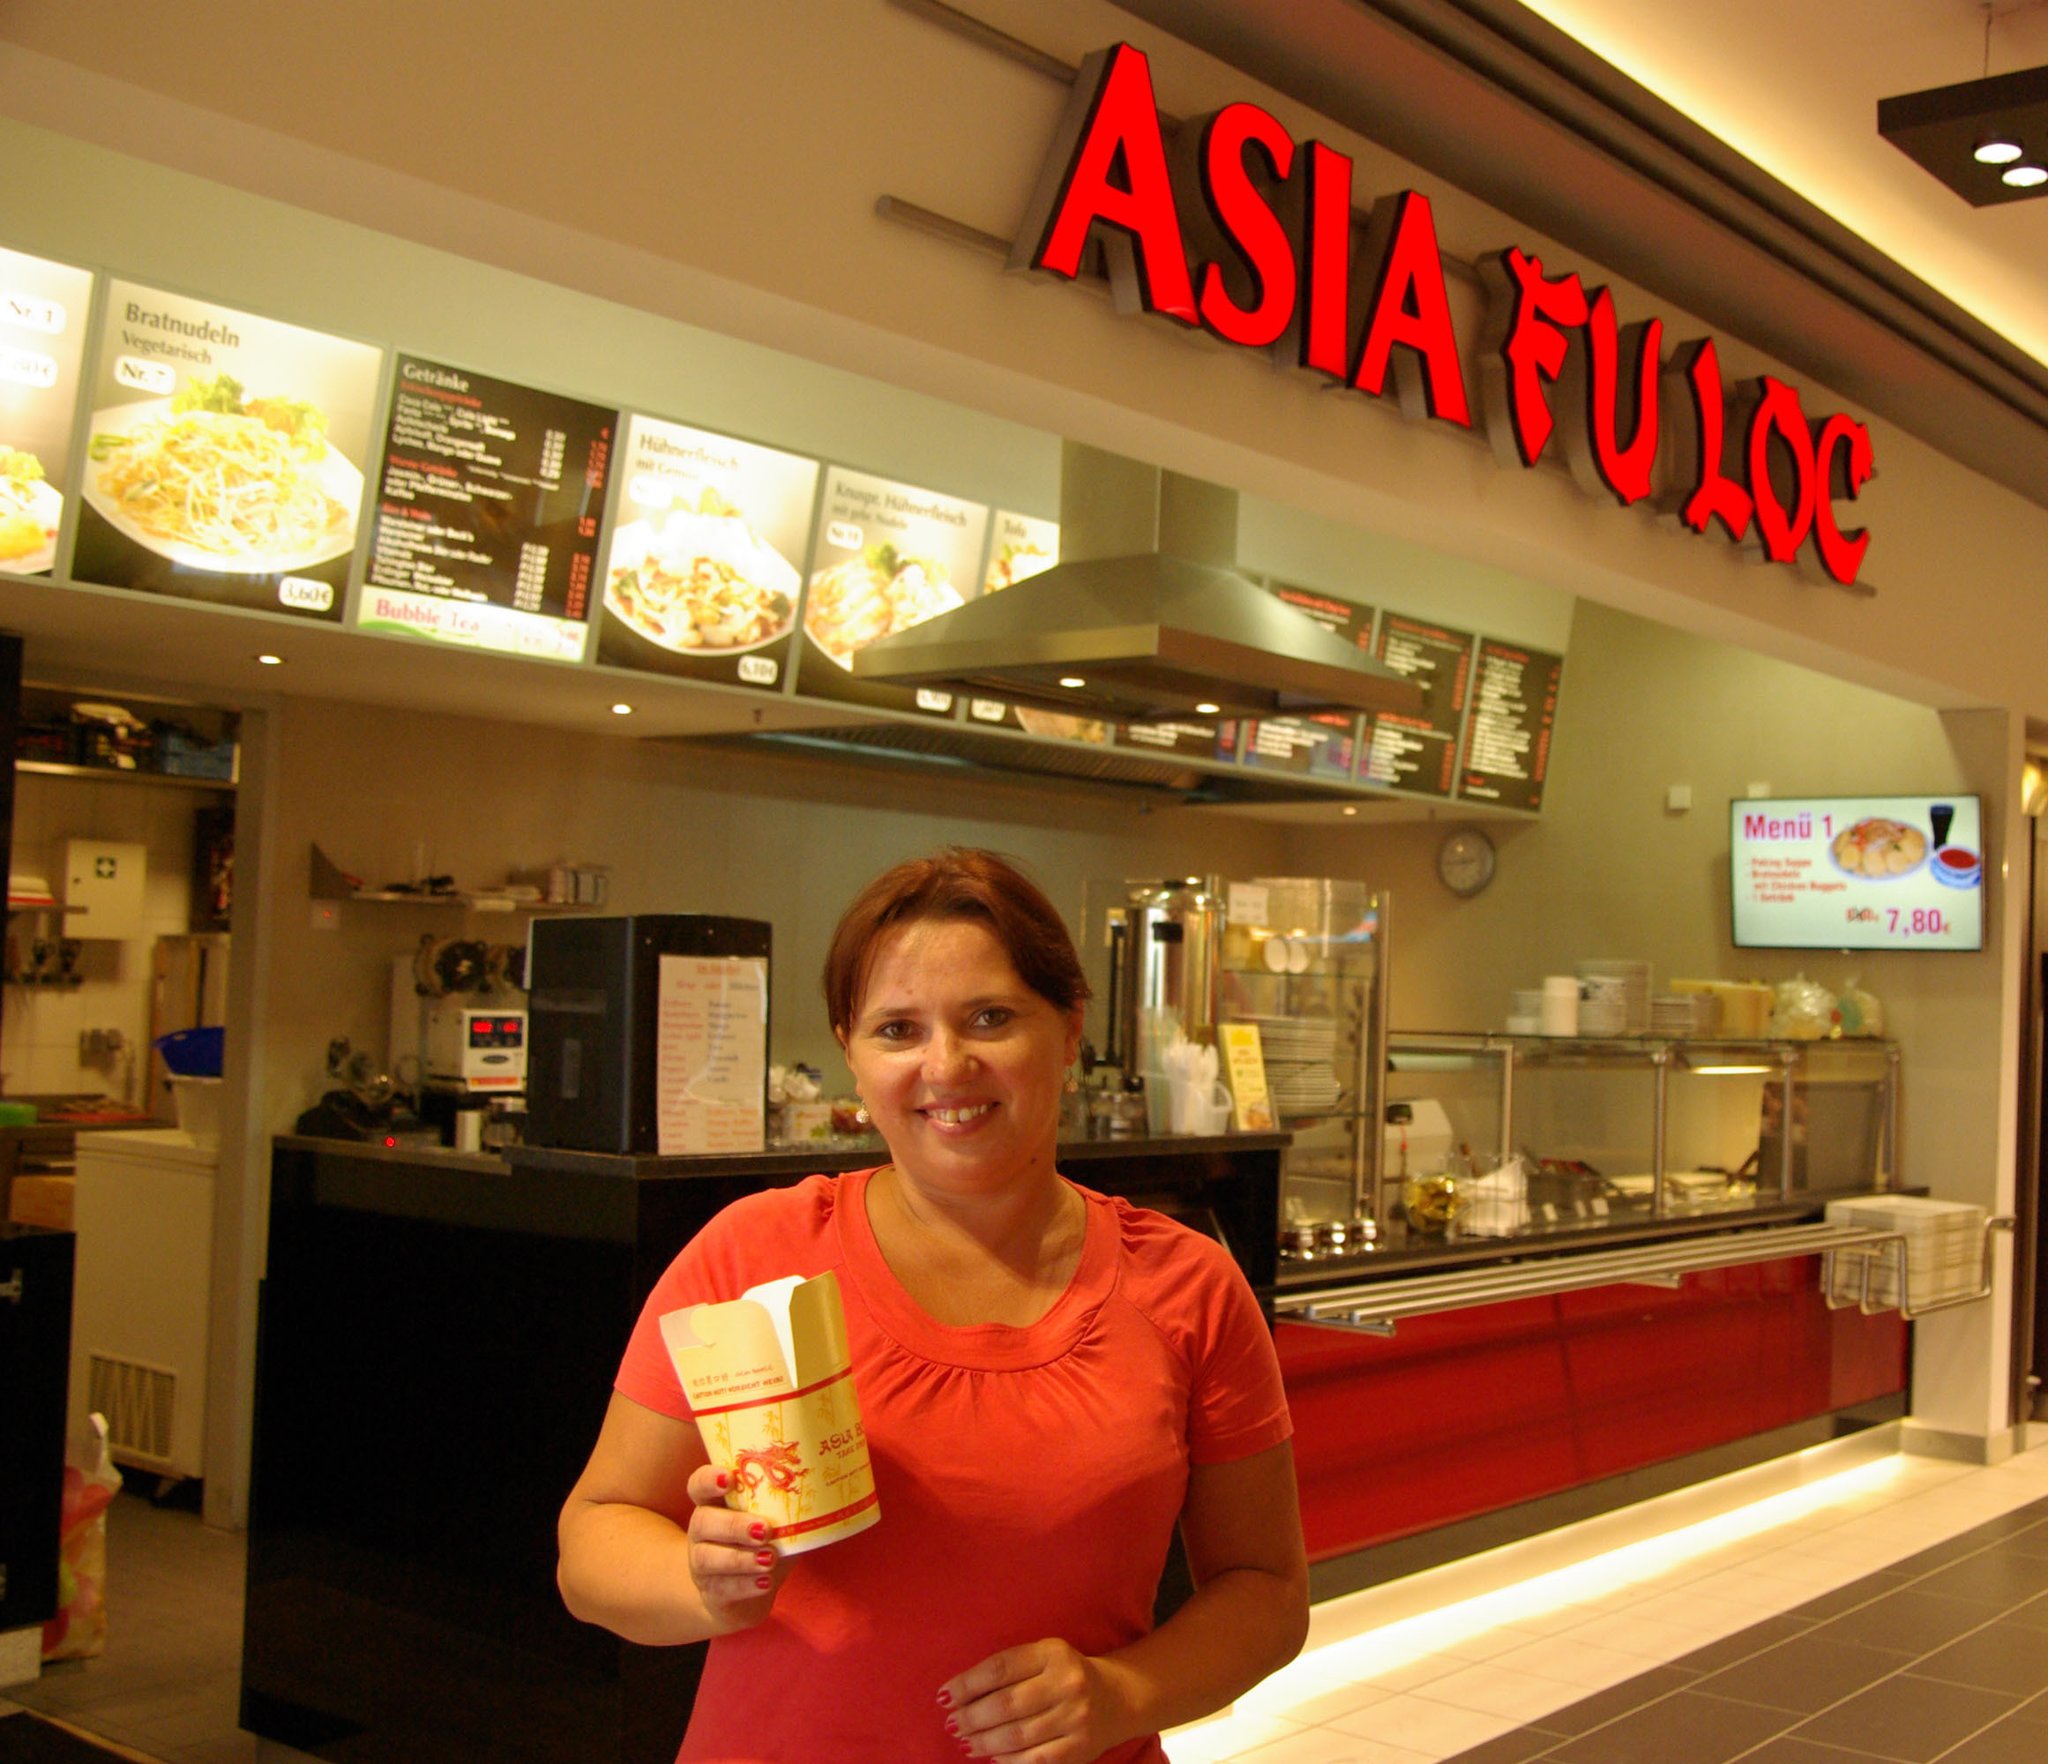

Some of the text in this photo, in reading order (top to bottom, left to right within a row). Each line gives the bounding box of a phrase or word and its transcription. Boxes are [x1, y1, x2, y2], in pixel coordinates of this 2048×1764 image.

[125, 302, 241, 348] Bratnudeln
[1040, 41, 1874, 586] ASIA FU LOC
[120, 328, 213, 366] Vegetarisch
[122, 361, 149, 382] Nr.
[402, 360, 470, 393] Getränke
[375, 597, 441, 626] Bubble
[1745, 811, 1833, 840] Menü 1
